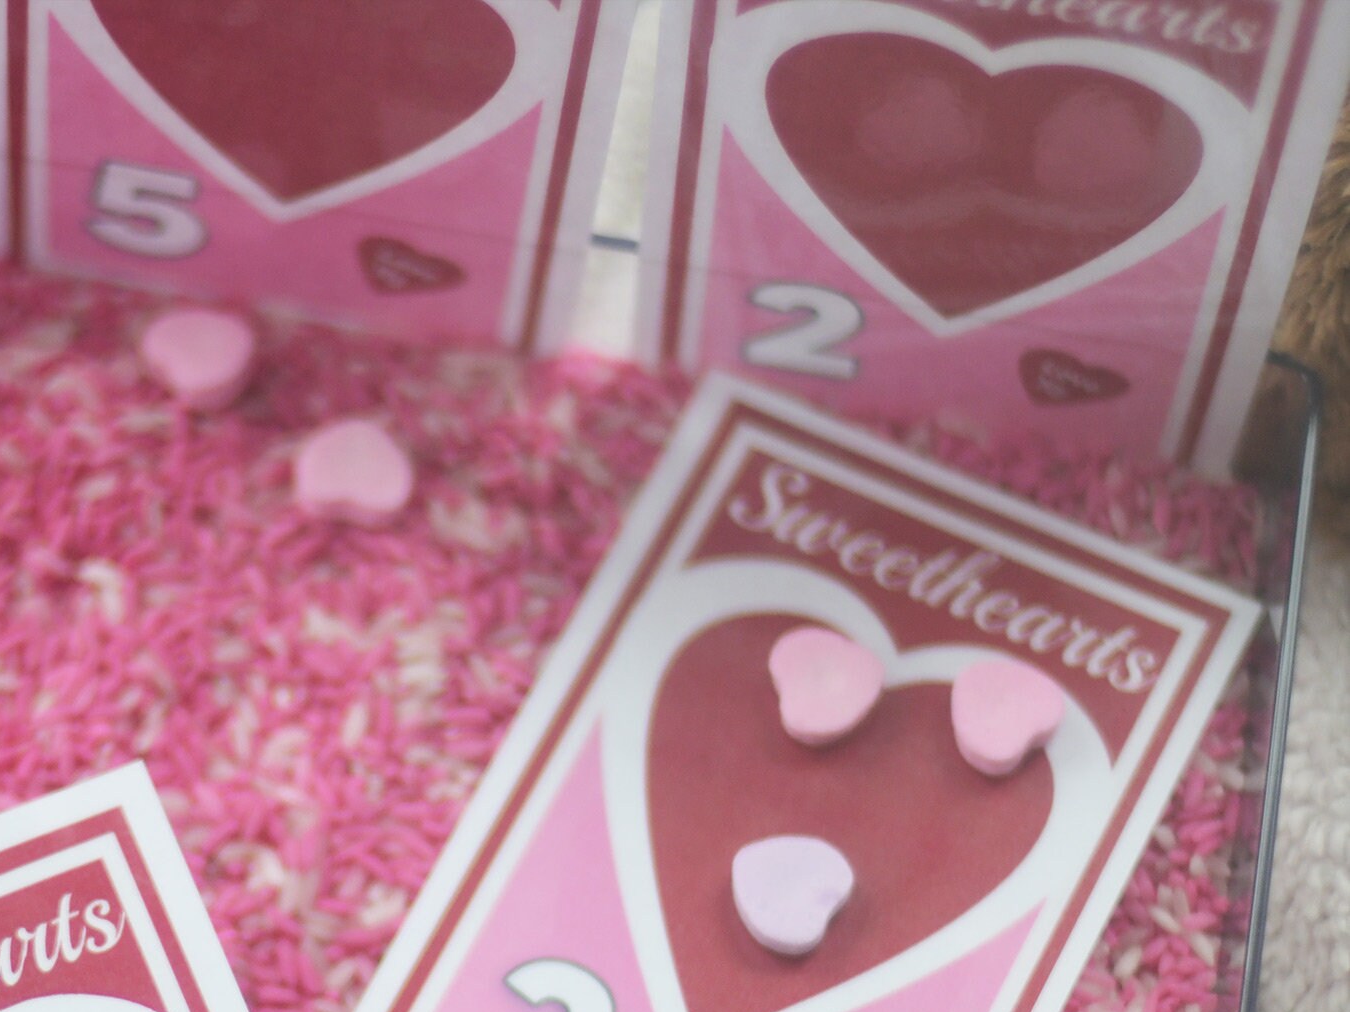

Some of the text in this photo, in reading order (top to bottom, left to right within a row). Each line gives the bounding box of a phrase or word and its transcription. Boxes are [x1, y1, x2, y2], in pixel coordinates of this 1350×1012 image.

[84, 158, 208, 259] 5
[741, 281, 865, 381] 2
[728, 464, 1158, 694] Sweethearts
